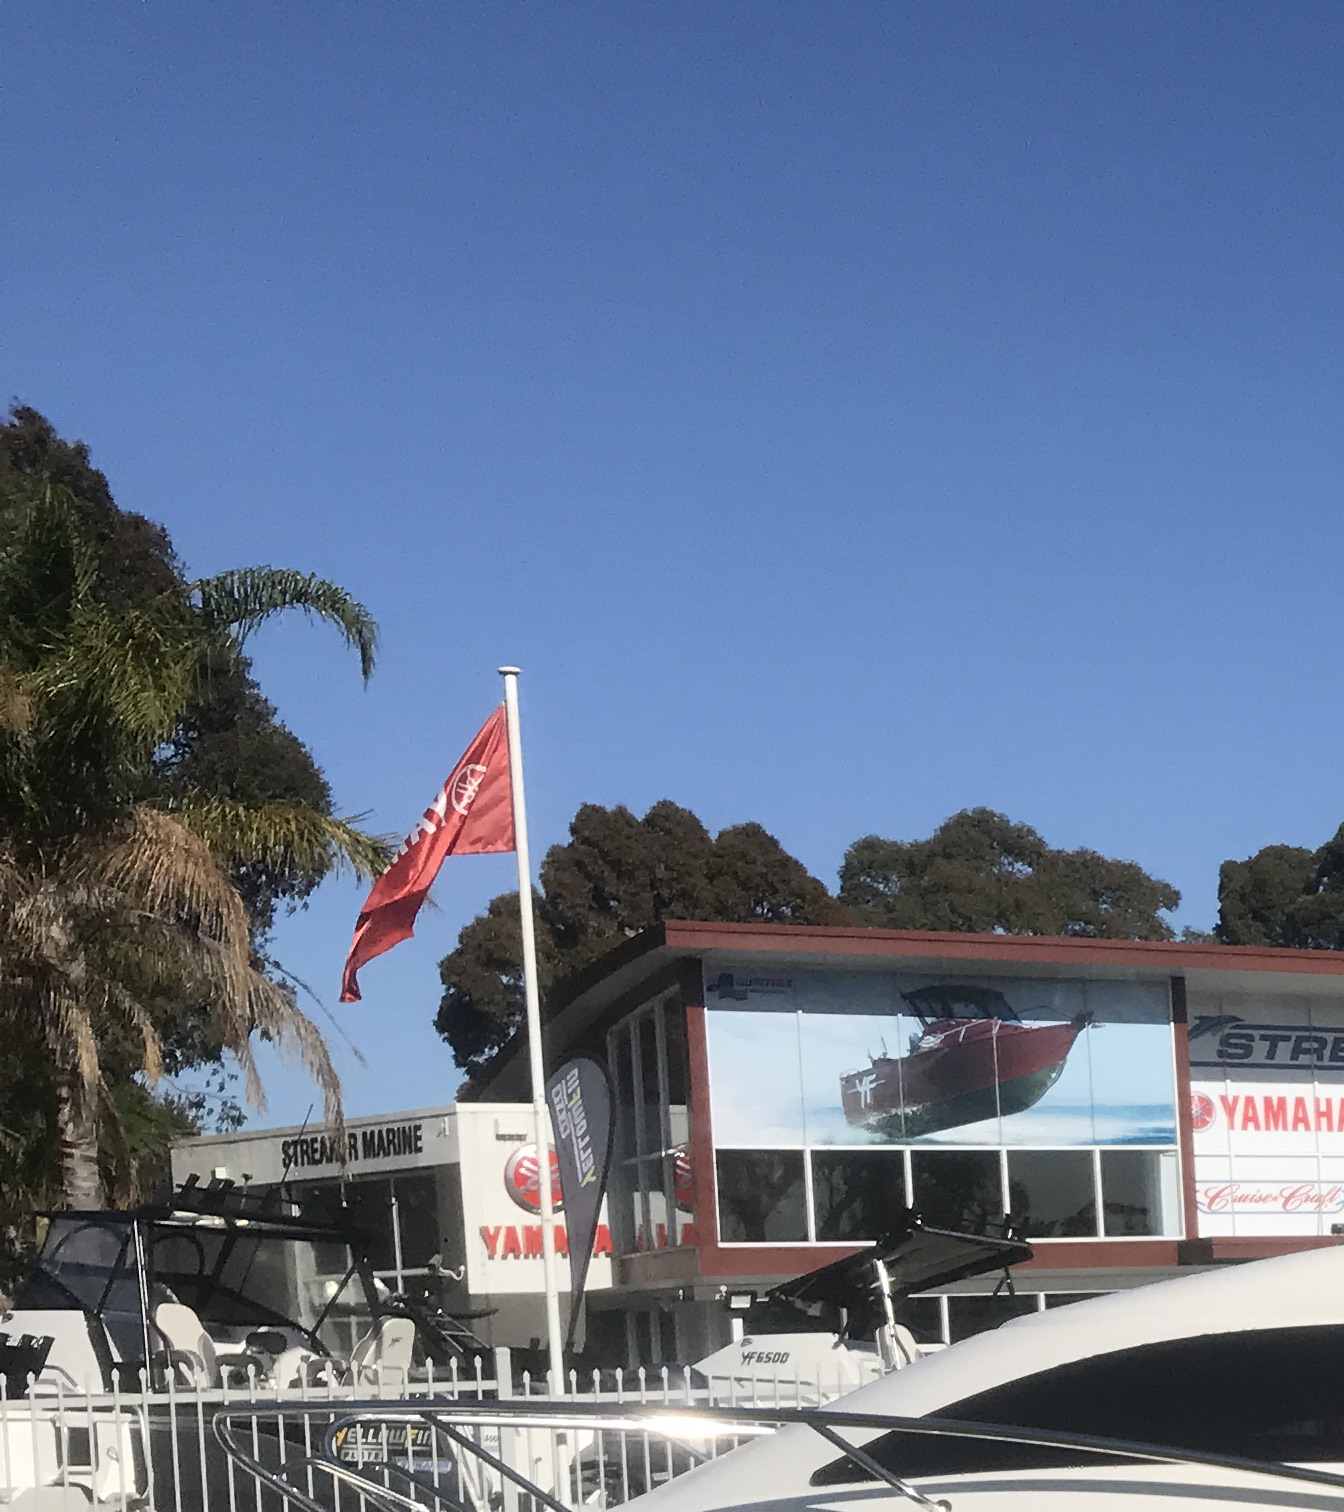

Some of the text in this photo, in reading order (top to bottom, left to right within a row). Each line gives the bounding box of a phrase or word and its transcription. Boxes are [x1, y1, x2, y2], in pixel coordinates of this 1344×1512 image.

[281, 1124, 423, 1168] STREAKR MARINE
[480, 1225, 613, 1259] YAMAA
